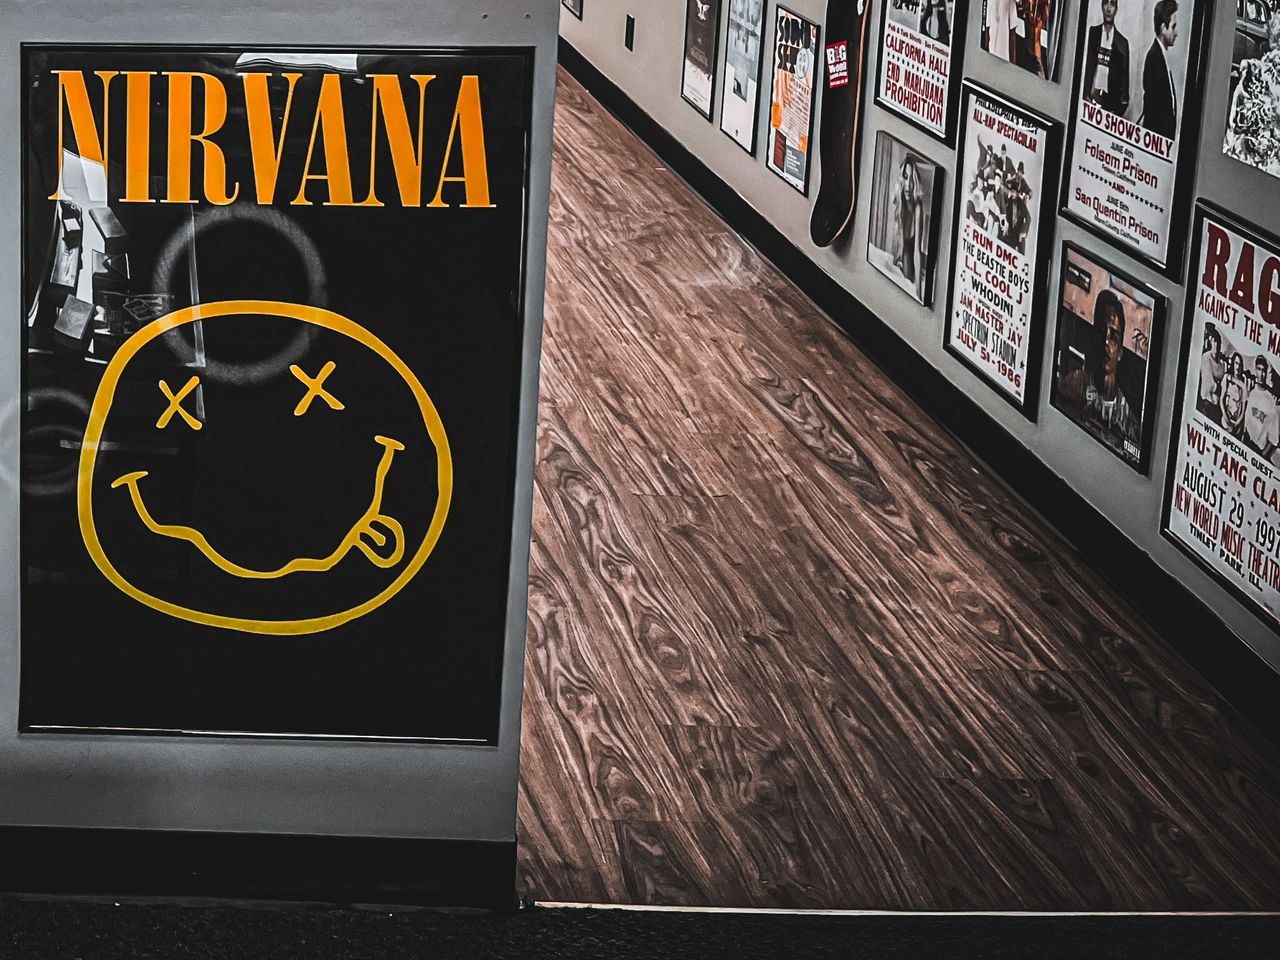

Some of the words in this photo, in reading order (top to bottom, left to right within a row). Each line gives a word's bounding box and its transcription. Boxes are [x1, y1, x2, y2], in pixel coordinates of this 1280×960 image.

[885, 33, 926, 67] CALIFORNIA
[928, 54, 948, 78] HALL
[886, 60, 900, 83] END
[904, 69, 944, 108] MARIJUANA
[884, 78, 943, 127] PROHIBITION
[973, 108, 996, 130] ALL-RAP
[997, 120, 1037, 153] SPECTACULAR
[1082, 101, 1103, 126] TWO
[1104, 111, 1141, 144] SHOWS
[1143, 131, 1174, 158] ONLY
[50, 69, 497, 209] NIRVANA
[1084, 138, 1121, 170] Folsom
[1122, 157, 1158, 189] Prison
[1075, 187, 1092, 209] San
[1092, 196, 1127, 227] Quentin
[1128, 216, 1159, 245] Prison
[1111, 181, 1126, 195] AND
[963, 237, 975, 257] THE
[976, 248, 1006, 279] BEASTIE
[1008, 269, 1030, 294] BOYS
[973, 228, 993, 253] RUN
[996, 244, 1018, 269] DMC
[1201, 221, 1280, 330] RAG
[965, 254, 982, 278] L.L.
[985, 270, 1013, 300] COOL
[1016, 291, 1023, 305] J
[971, 275, 1014, 319] WHODINI
[959, 292, 973, 312] JAM
[975, 303, 1004, 336] MASTER
[1007, 328, 1023, 348] JAY
[1198, 288, 1239, 330] AGAINST
[1243, 314, 1264, 346] THE
[956, 327, 978, 353] JULY
[997, 360, 1021, 388] 1986
[1186, 423, 1248, 488] WU-TANG
[1203, 422, 1220, 441] WITH
[1222, 435, 1249, 463] SPECIAL
[1250, 456, 1274, 480] GUEST
[1174, 482, 1192, 518] NEW
[1191, 493, 1221, 541] WORLD
[1220, 520, 1246, 564] MUSIC
[1182, 461, 1227, 514] AUGUST
[1228, 496, 1244, 529] 29
[1189, 522, 1217, 553] TINLEY
[1219, 548, 1246, 580] PARK,
